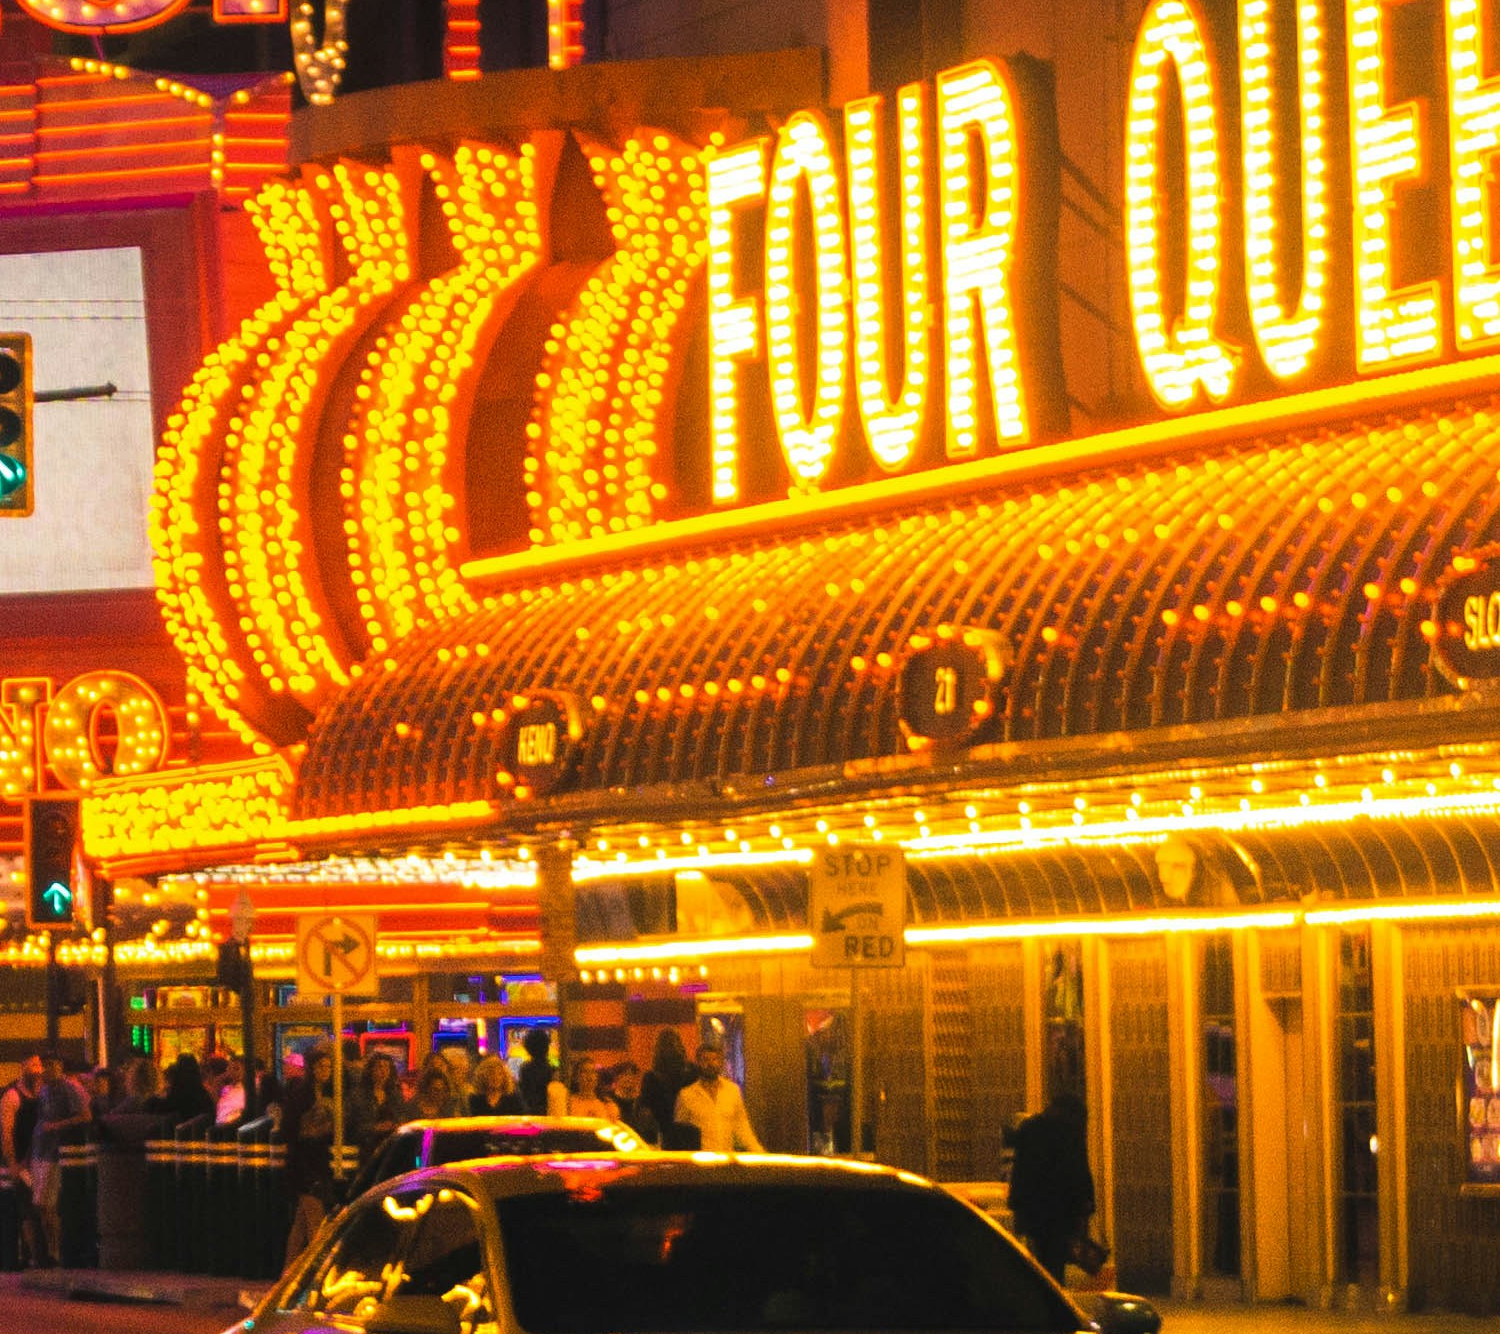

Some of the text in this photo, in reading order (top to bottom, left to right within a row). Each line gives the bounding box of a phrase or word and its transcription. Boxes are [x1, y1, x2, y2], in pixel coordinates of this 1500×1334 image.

[702, 55, 1033, 506] FOUR
[518, 721, 557, 766] KENO
[824, 853, 892, 878] STOP
[844, 935, 895, 959] RED
